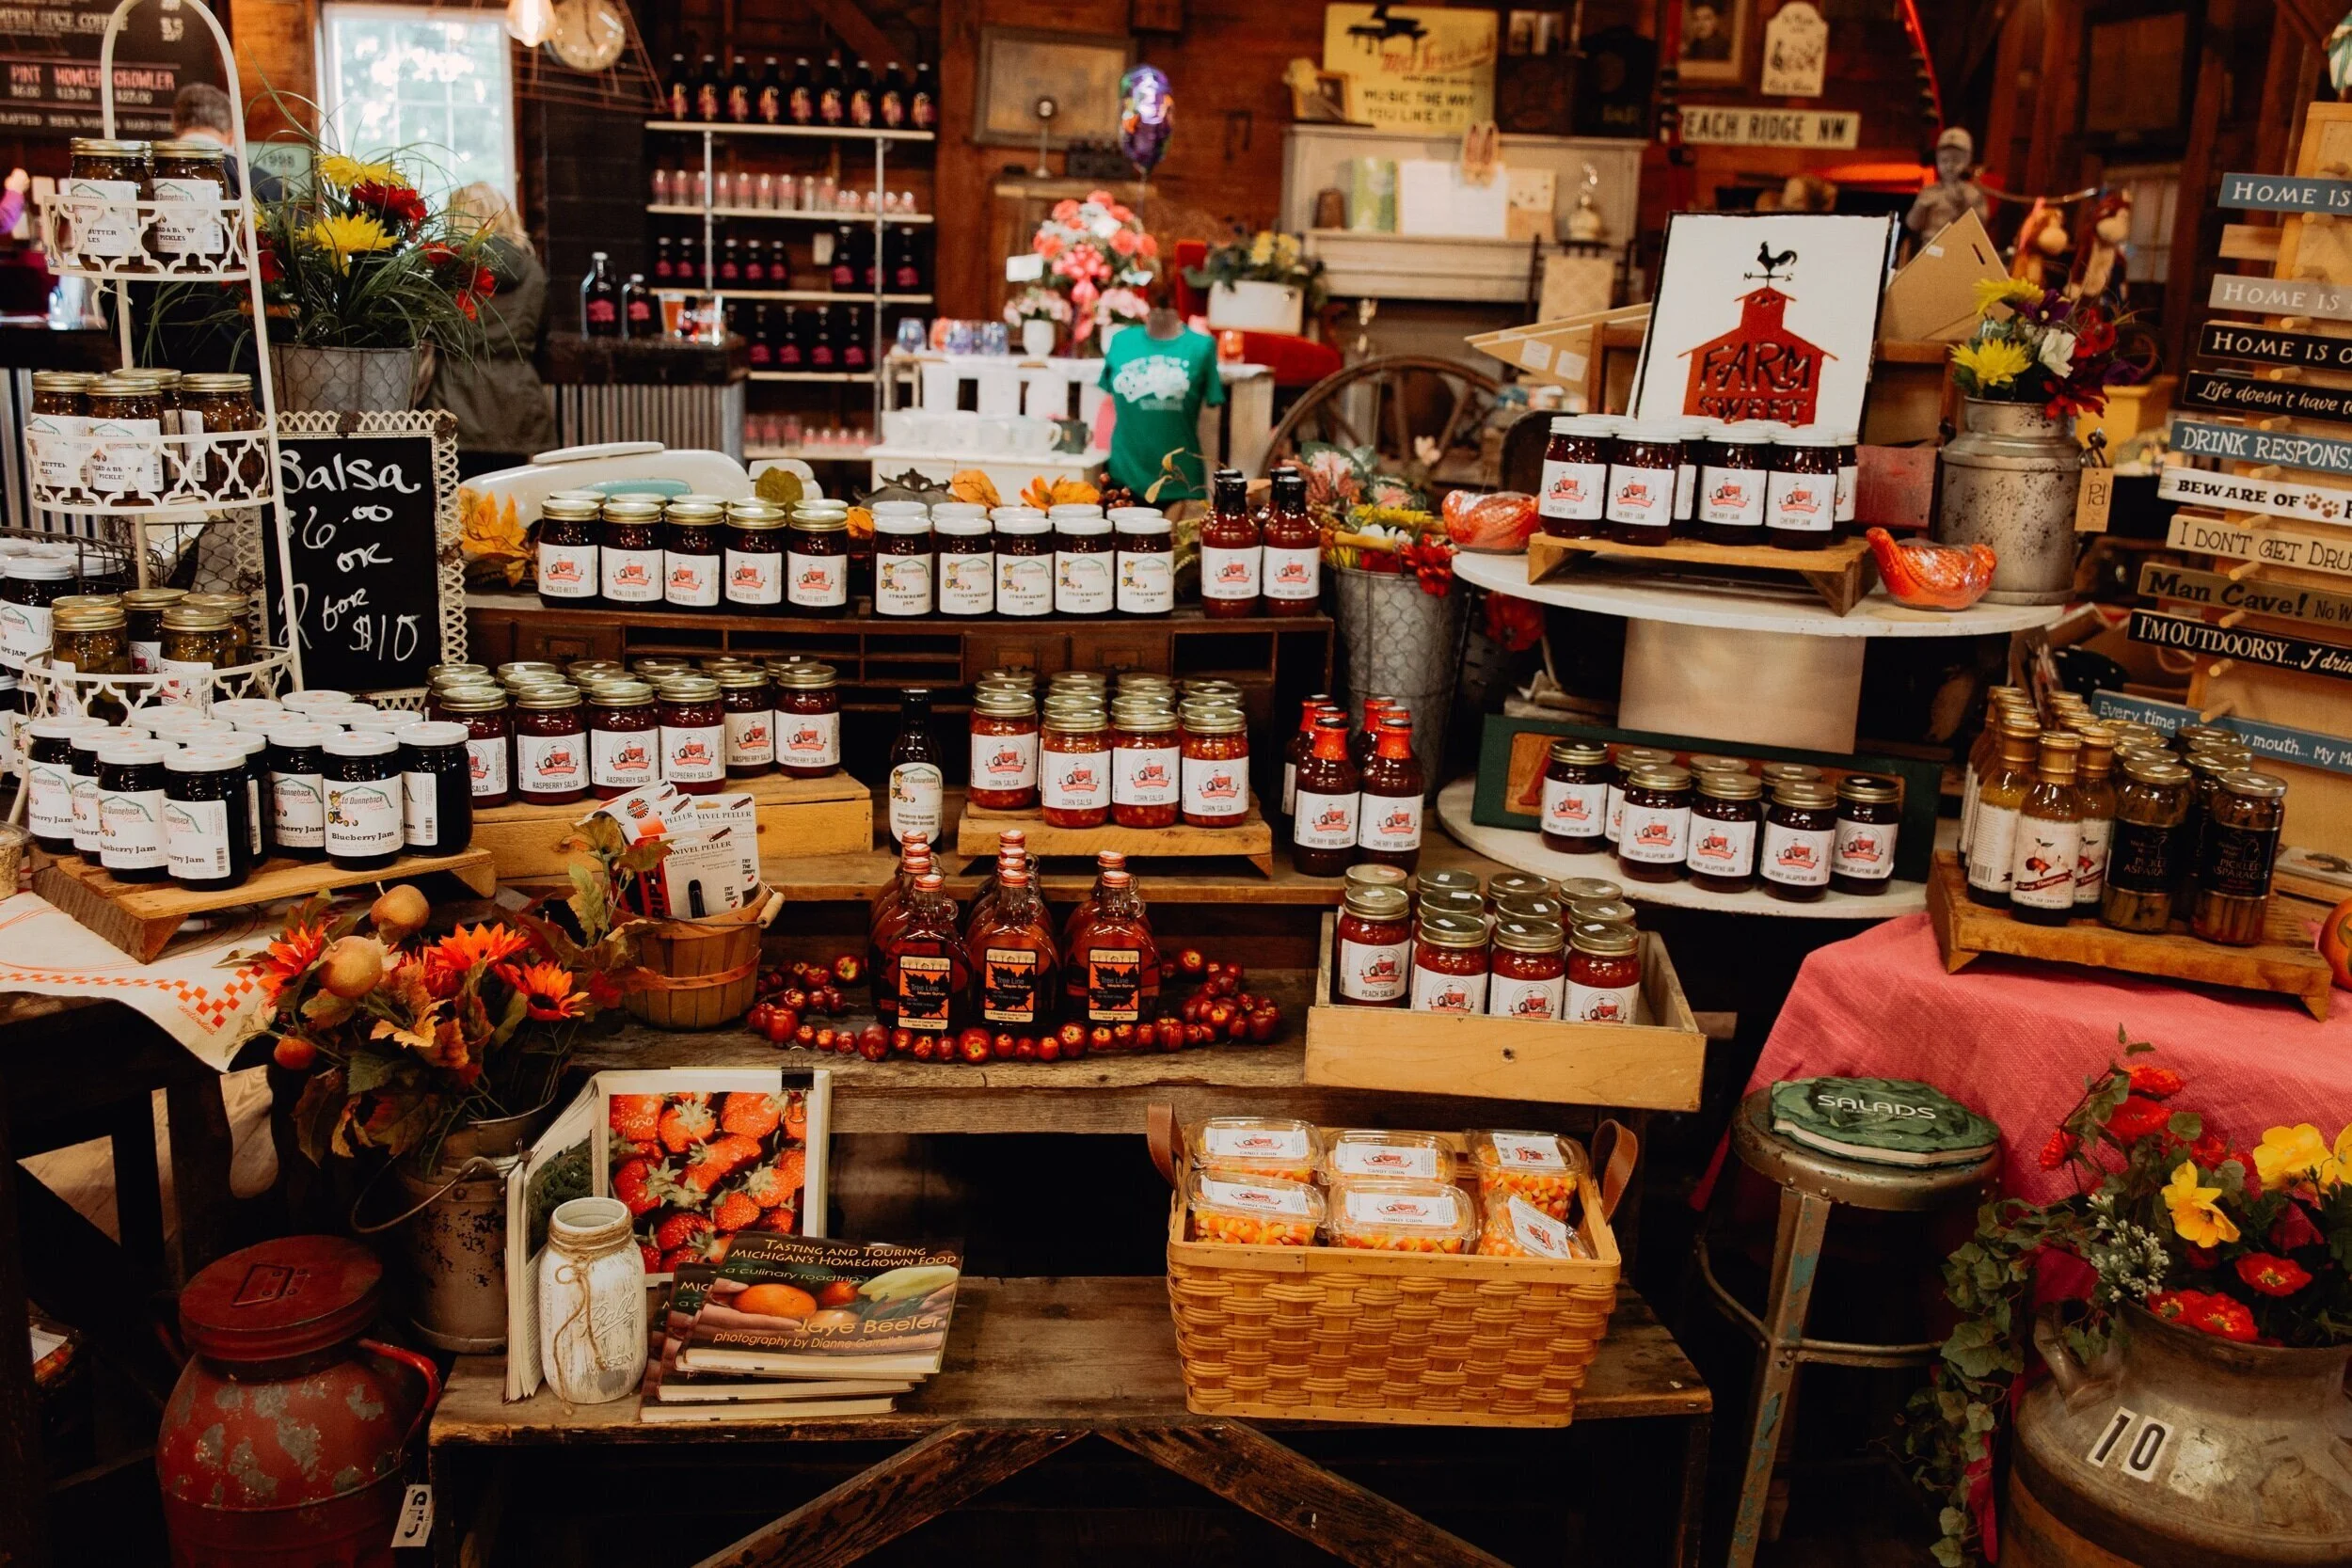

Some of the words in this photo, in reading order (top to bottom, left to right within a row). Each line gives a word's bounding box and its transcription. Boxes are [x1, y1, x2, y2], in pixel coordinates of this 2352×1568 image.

[10, 64, 41, 84] PINT
[1684, 110, 1738, 137] EACH
[1748, 115, 1805, 141] RIDGE
[1818, 118, 1850, 142] NW
[2233, 182, 2316, 205] HOME
[2328, 189, 2351, 207] IS
[2222, 283, 2306, 309] HOME
[2317, 293, 2341, 311] IS
[2212, 332, 2295, 357] HOME
[2305, 343, 2329, 362] IS
[1698, 341, 1812, 392] FARM
[2198, 380, 2231, 401] Life
[2235, 385, 2296, 408] doesn't
[2298, 392, 2339, 412] have
[1698, 396, 1808, 423] SWEET
[2181, 427, 2249, 456] DRINK
[2255, 436, 2352, 470] RESPONS
[280, 449, 421, 494] Salsa
[2177, 479, 2267, 503] BEWARE
[2273, 493, 2301, 508] OF
[2179, 522, 2188, 546] I
[2194, 528, 2253, 555] DON'T
[2258, 539, 2303, 562] GET
[2148, 570, 2211, 603] Man
[2220, 582, 2310, 617] Cave!
[349, 613, 421, 661] $10
[2137, 614, 2169, 641] I'M
[2144, 711, 2176, 728] time
[2313, 745, 2336, 764] My
[471, 784, 489, 793] SALSA
[532, 782, 563, 790] RASPBERRY
[664, 812, 693, 825] PEELER
[722, 811, 753, 819] PEELER
[101, 842, 135, 855] lueberry
[135, 845, 157, 854] Jam
[331, 832, 376, 843] Blueberry
[377, 830, 395, 842] Jam
[701, 841, 732, 851] PEELER
[185, 854, 206, 864] Jam
[1361, 989, 1379, 998] PEACH
[1380, 988, 1395, 998] SALSA
[1818, 1094, 1936, 1119] SALADS
[730, 1248, 815, 1265] MICHIGAN'S
[818, 1256, 914, 1268] HOMEGROWN
[918, 1255, 957, 1266] FOOD
[765, 1239, 823, 1256] TASTING
[826, 1247, 859, 1258] AND
[863, 1246, 927, 1258] TOURING
[739, 1267, 798, 1280] culinary
[800, 1272, 861, 1284] roadtrip
[794, 1317, 856, 1338] Jaye
[864, 1315, 942, 1334] Beeler
[713, 1331, 791, 1349] photography
[793, 1335, 809, 1349] by
[811, 1337, 851, 1349] Dianne
[2094, 1414, 2166, 1472] 10
